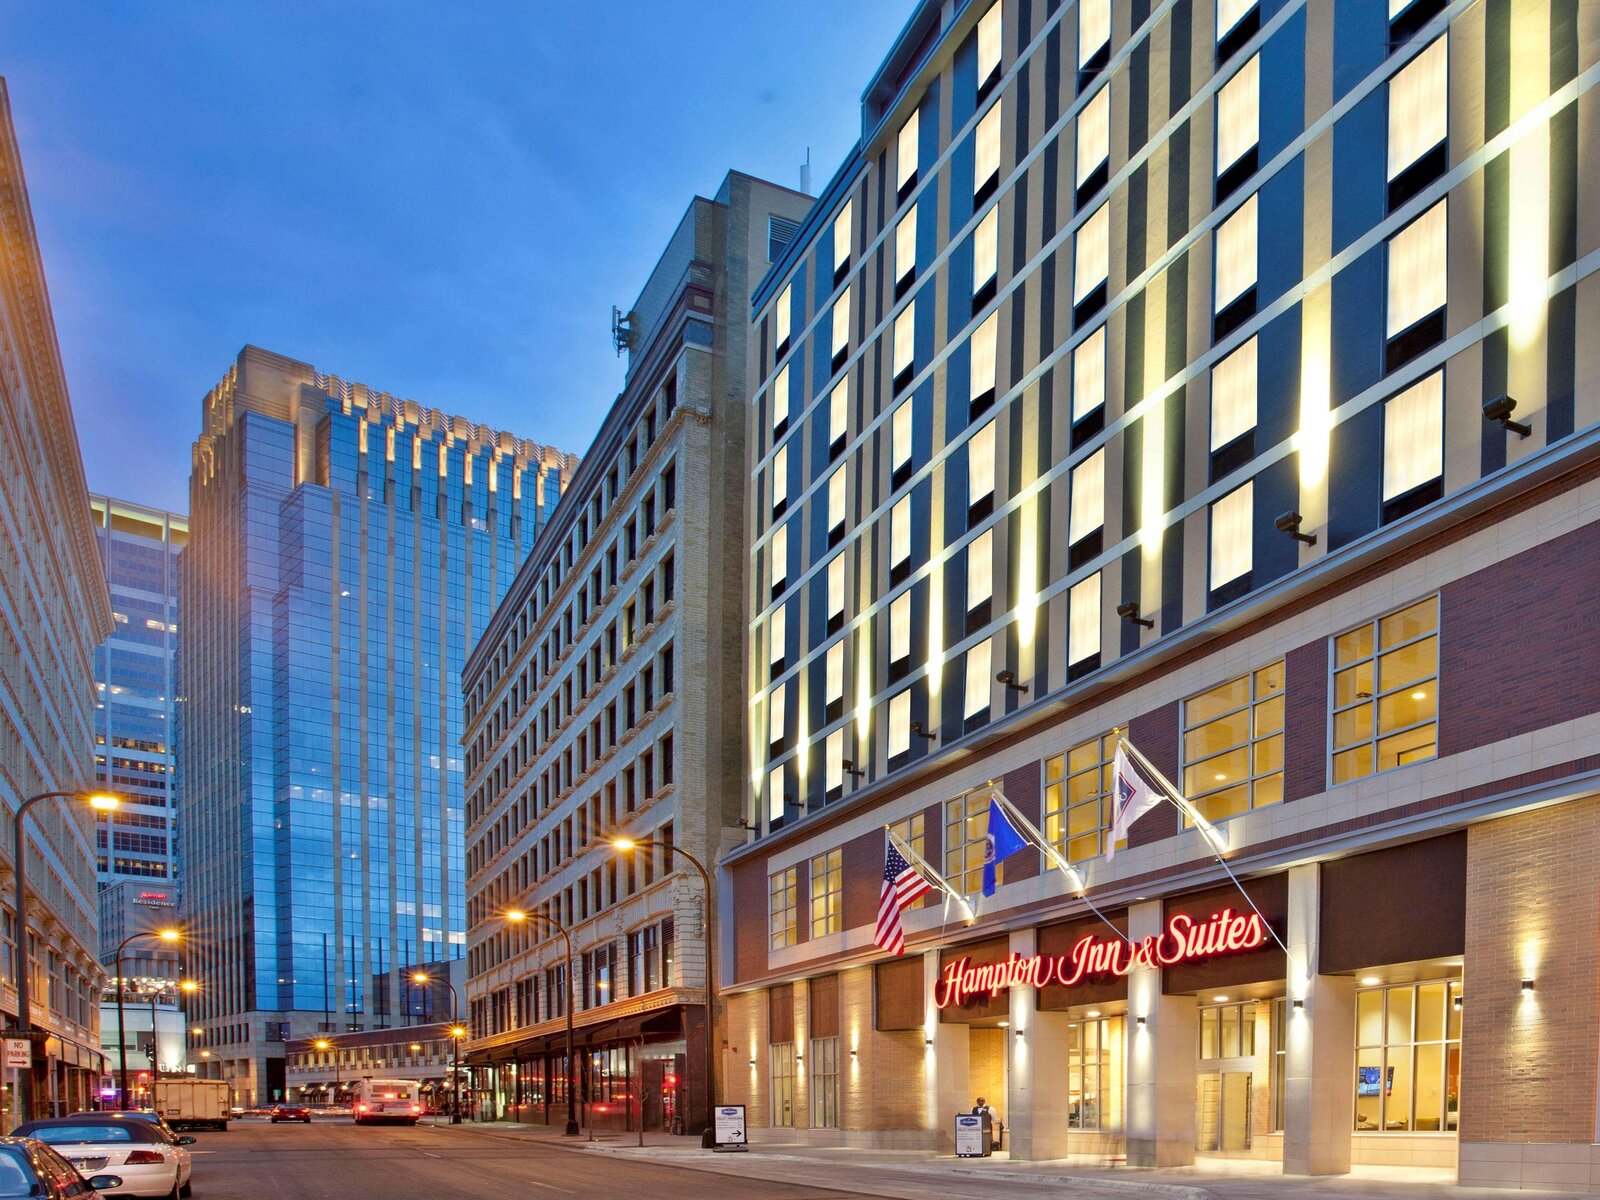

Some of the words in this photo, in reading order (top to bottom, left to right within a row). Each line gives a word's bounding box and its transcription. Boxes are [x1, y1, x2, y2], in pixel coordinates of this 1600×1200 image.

[132, 898, 175, 907] Residence
[933, 951, 1054, 1009] Hampton
[1057, 934, 1136, 986] Inn
[1136, 935, 1159, 970] &
[1157, 907, 1263, 965] Suites
[13, 1041, 24, 1049] NO
[7, 1050, 29, 1058] PARKING
